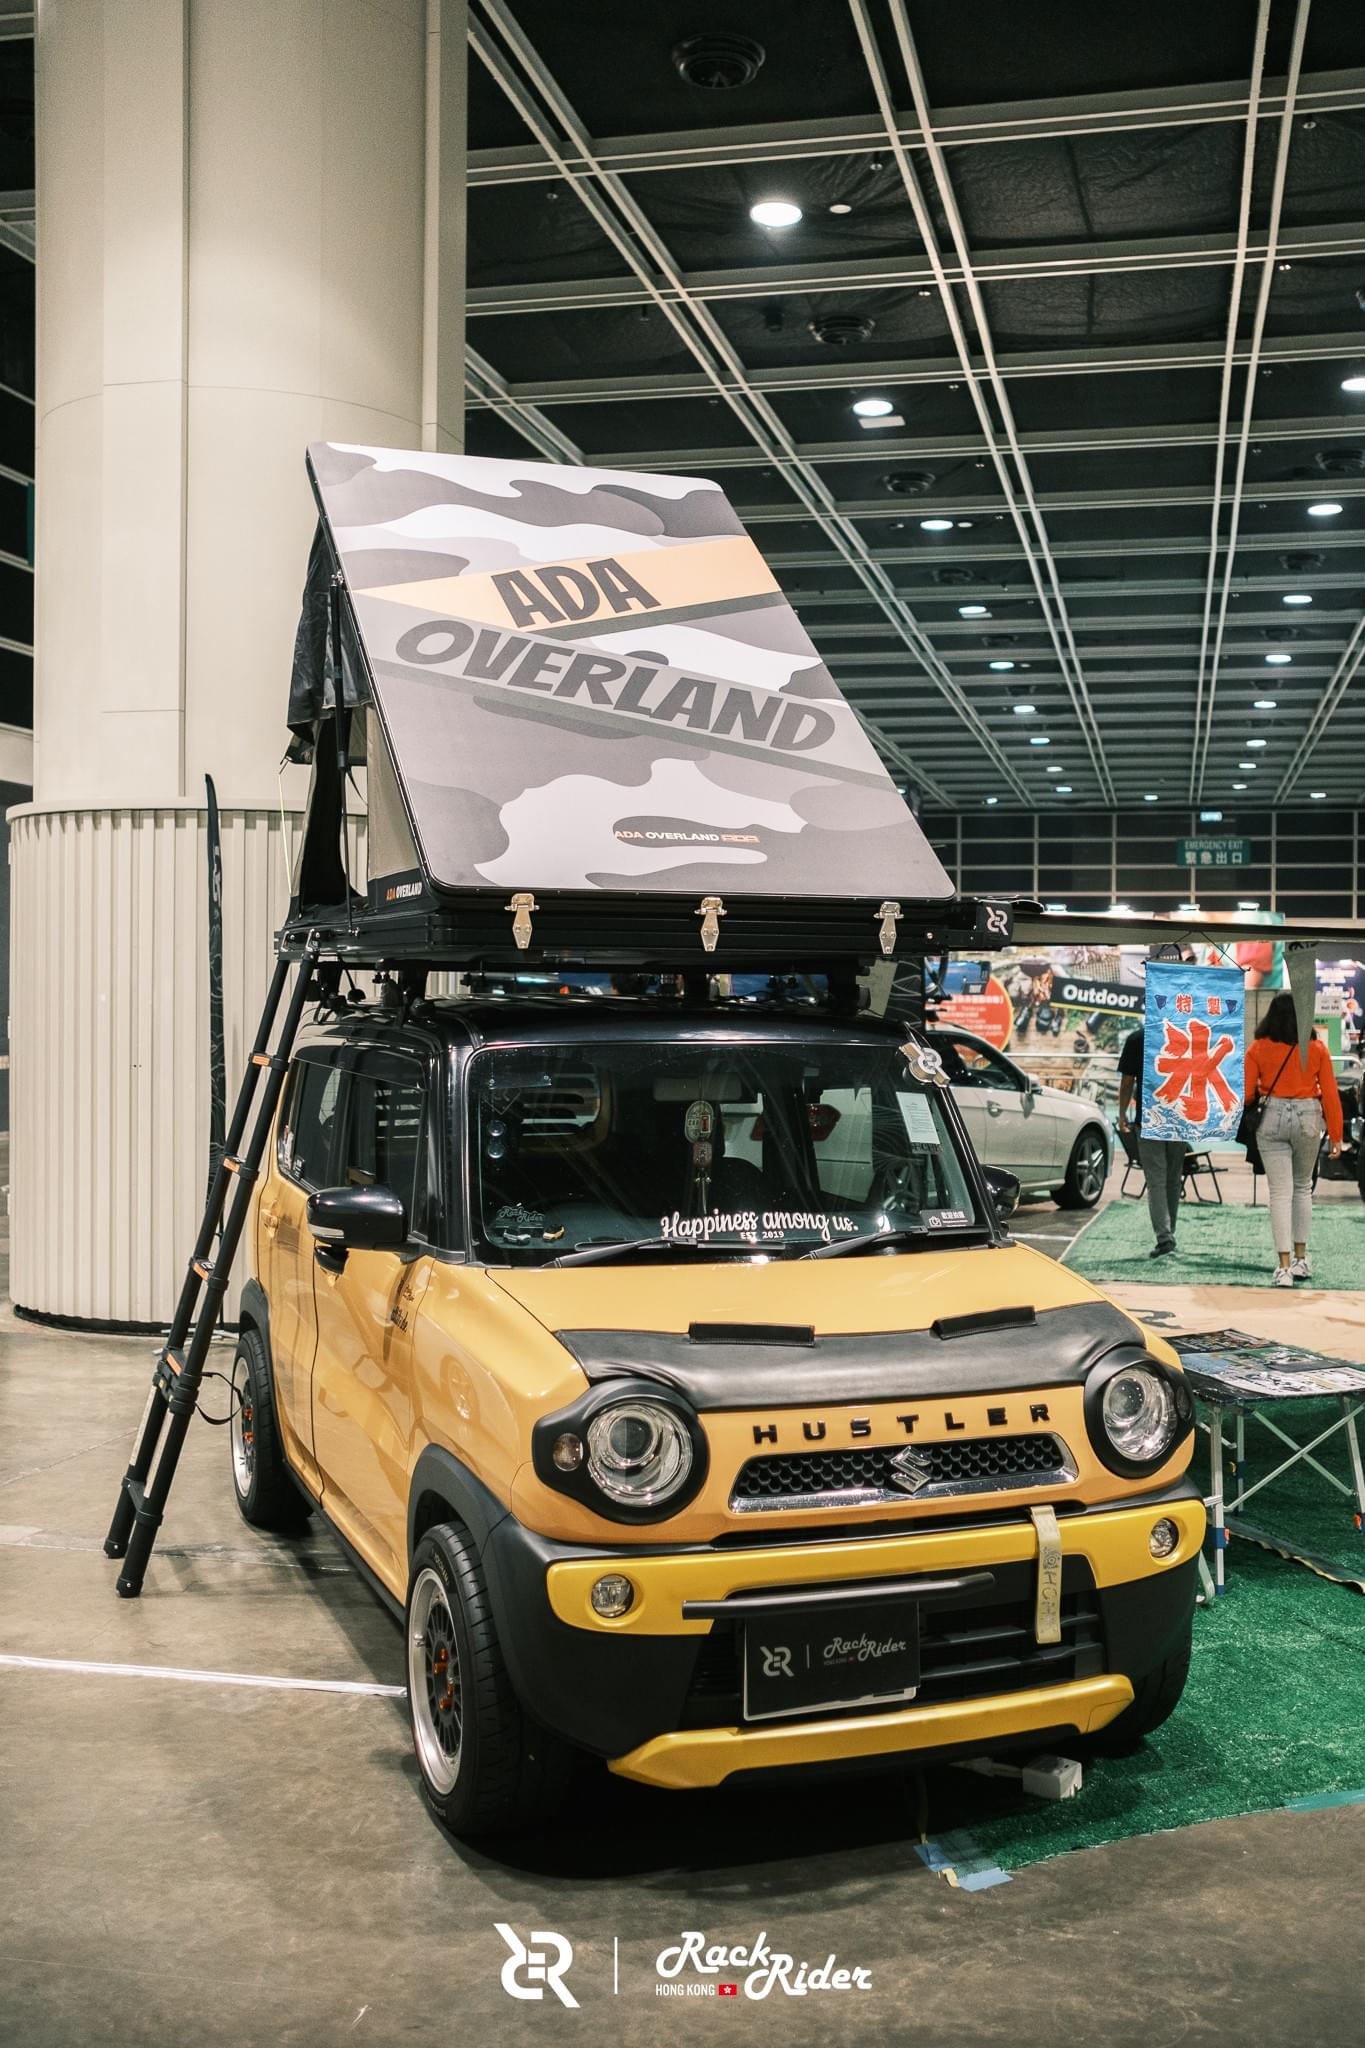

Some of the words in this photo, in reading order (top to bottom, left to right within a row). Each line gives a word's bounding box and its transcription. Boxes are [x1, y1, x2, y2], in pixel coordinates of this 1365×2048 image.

[490, 557, 661, 628] ADA
[395, 619, 836, 752] OVERLAND
[614, 830, 644, 839] ADA
[645, 831, 720, 841] OVERLAND
[1185, 840, 1227, 850] EMERGENCY
[1228, 840, 1243, 849] EXIT
[396, 881, 423, 899] OVERLAND
[1063, 984, 1139, 1009] Outdoor
[661, 1208, 758, 1240] Happiness
[762, 1211, 829, 1241] among
[762, 1231, 784, 1239] 2019
[753, 1404, 1050, 1445] HUSTLER
[824, 1633, 868, 1658] Rack
[858, 1637, 907, 1661] Rider
